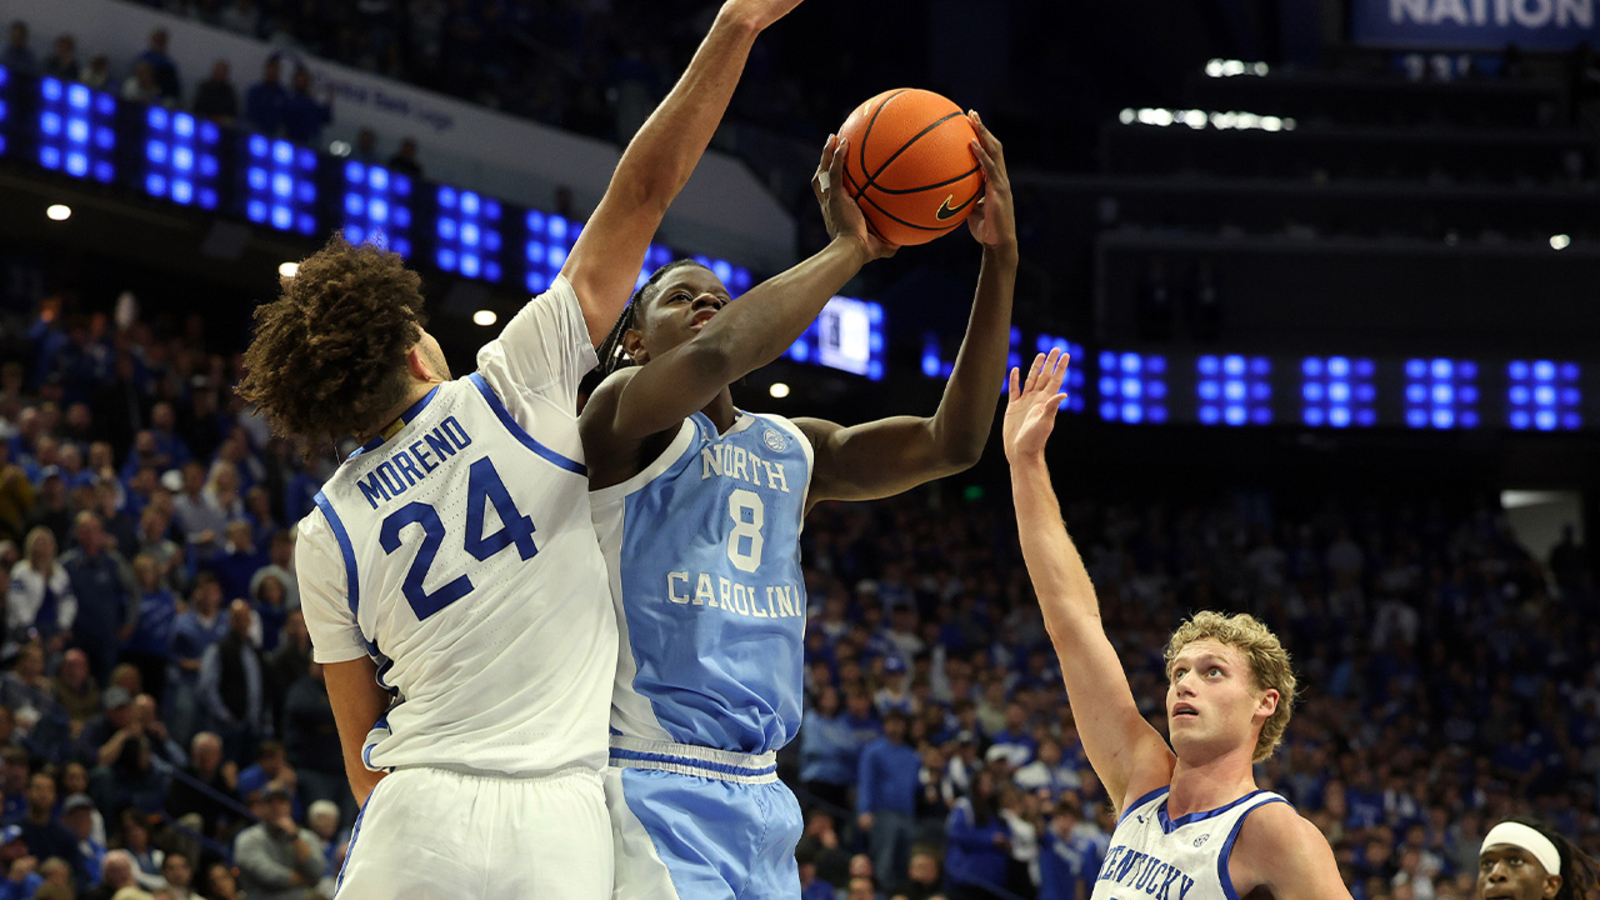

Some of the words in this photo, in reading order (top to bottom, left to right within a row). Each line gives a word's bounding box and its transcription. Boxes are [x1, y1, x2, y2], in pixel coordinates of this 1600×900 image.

[357, 416, 472, 510] MORENO
[701, 443, 790, 493] NORTH
[379, 456, 538, 621] 24
[727, 489, 764, 573] 8
